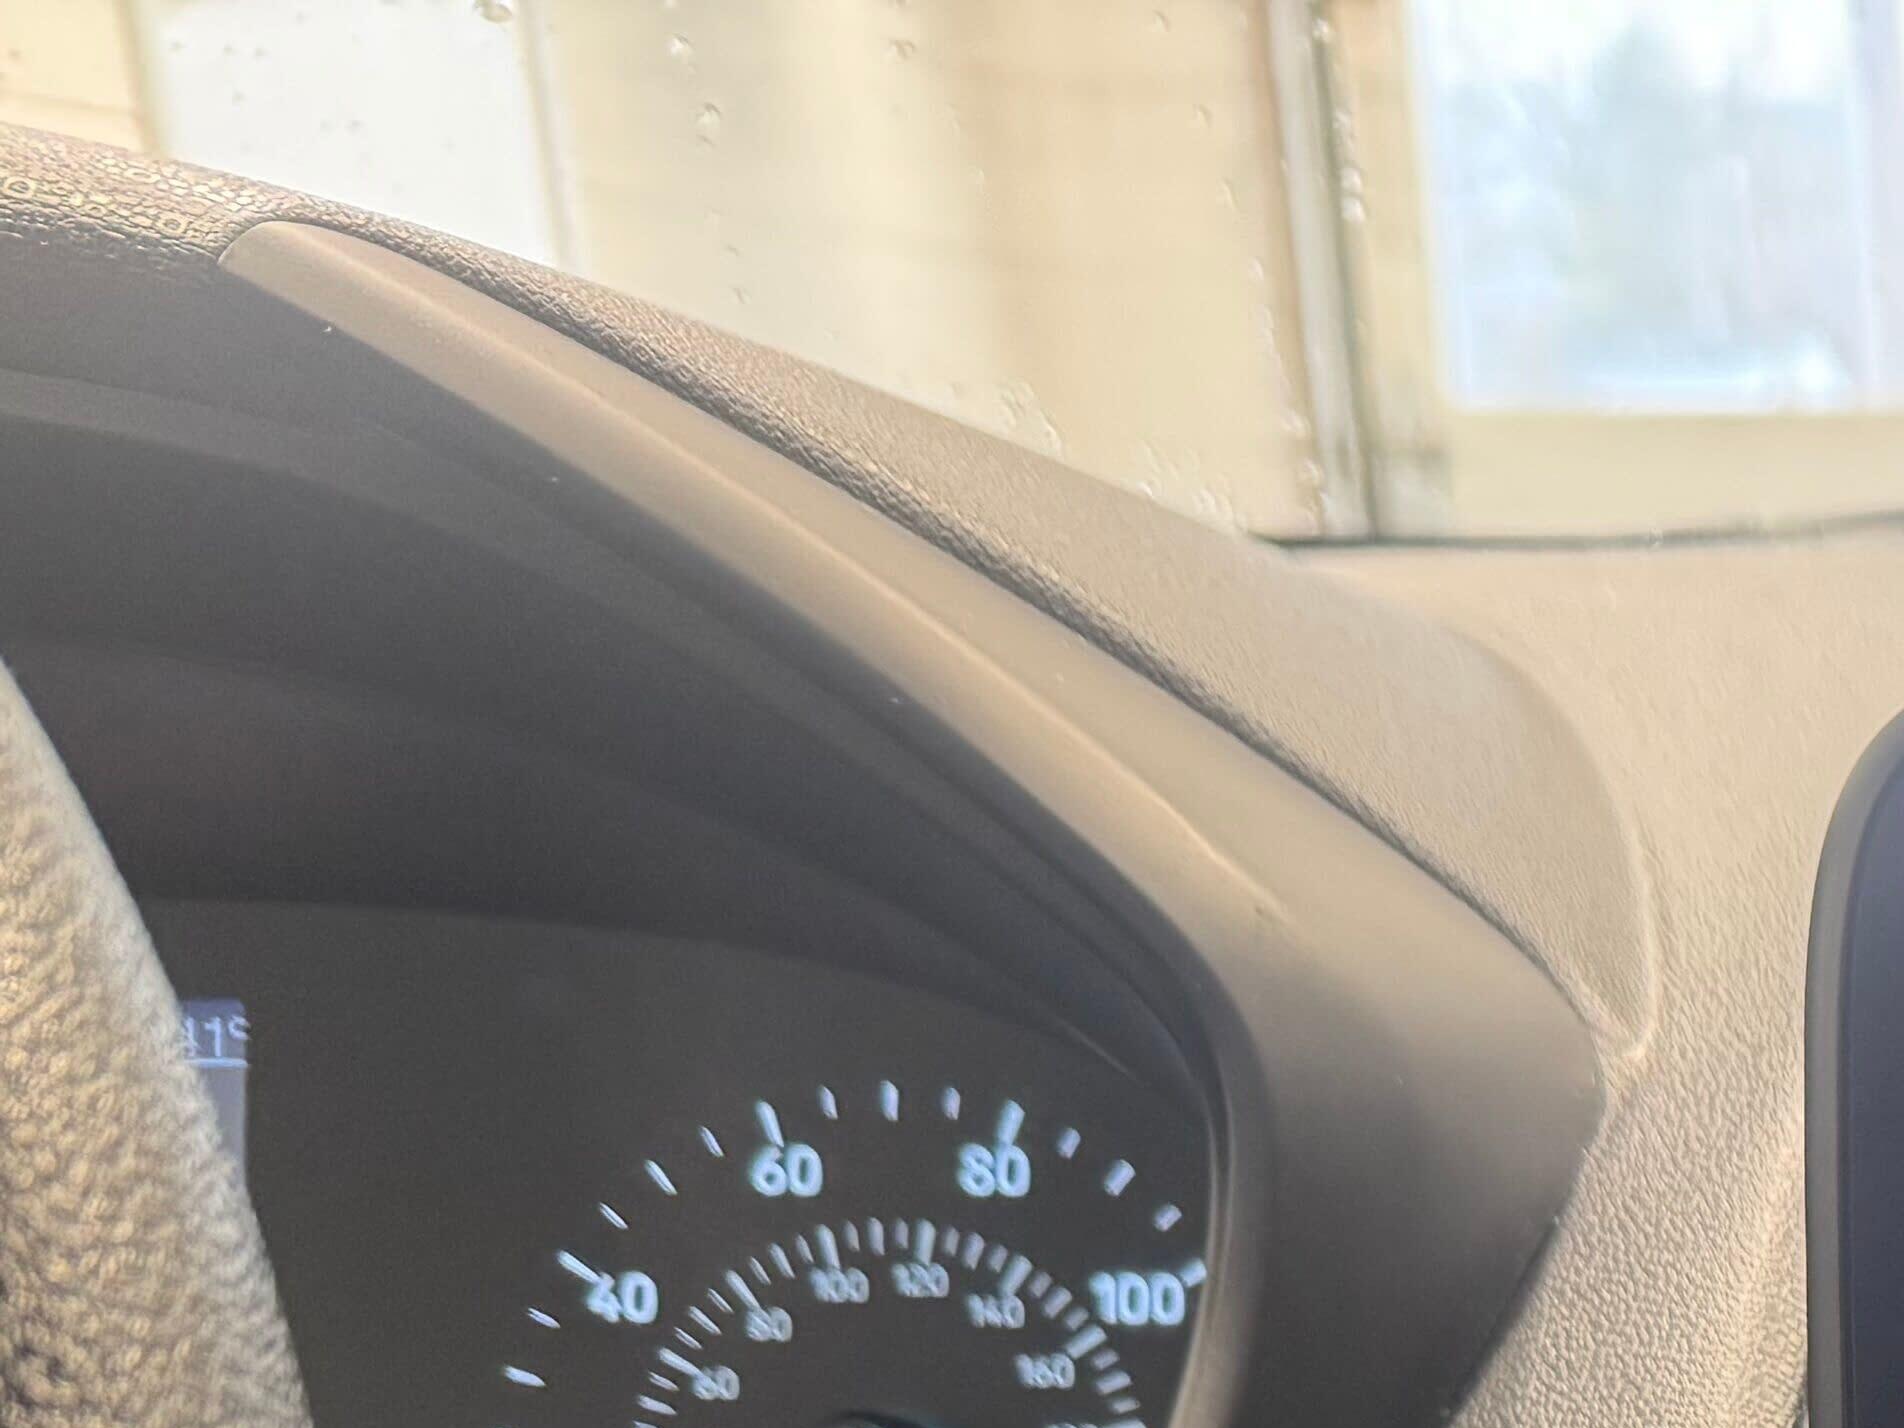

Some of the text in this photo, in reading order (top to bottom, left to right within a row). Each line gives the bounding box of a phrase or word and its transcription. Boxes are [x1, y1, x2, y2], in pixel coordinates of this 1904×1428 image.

[749, 1145, 823, 1197] 60
[957, 1145, 1033, 1197] 80
[586, 1271, 659, 1324] 40
[810, 1266, 870, 1303] 100
[891, 1263, 950, 1298] 120
[1089, 1271, 1187, 1326] 100
[745, 1305, 793, 1342] 80
[965, 1294, 1025, 1329] 140
[691, 1364, 740, 1401] 60
[1014, 1352, 1076, 1389] 160
